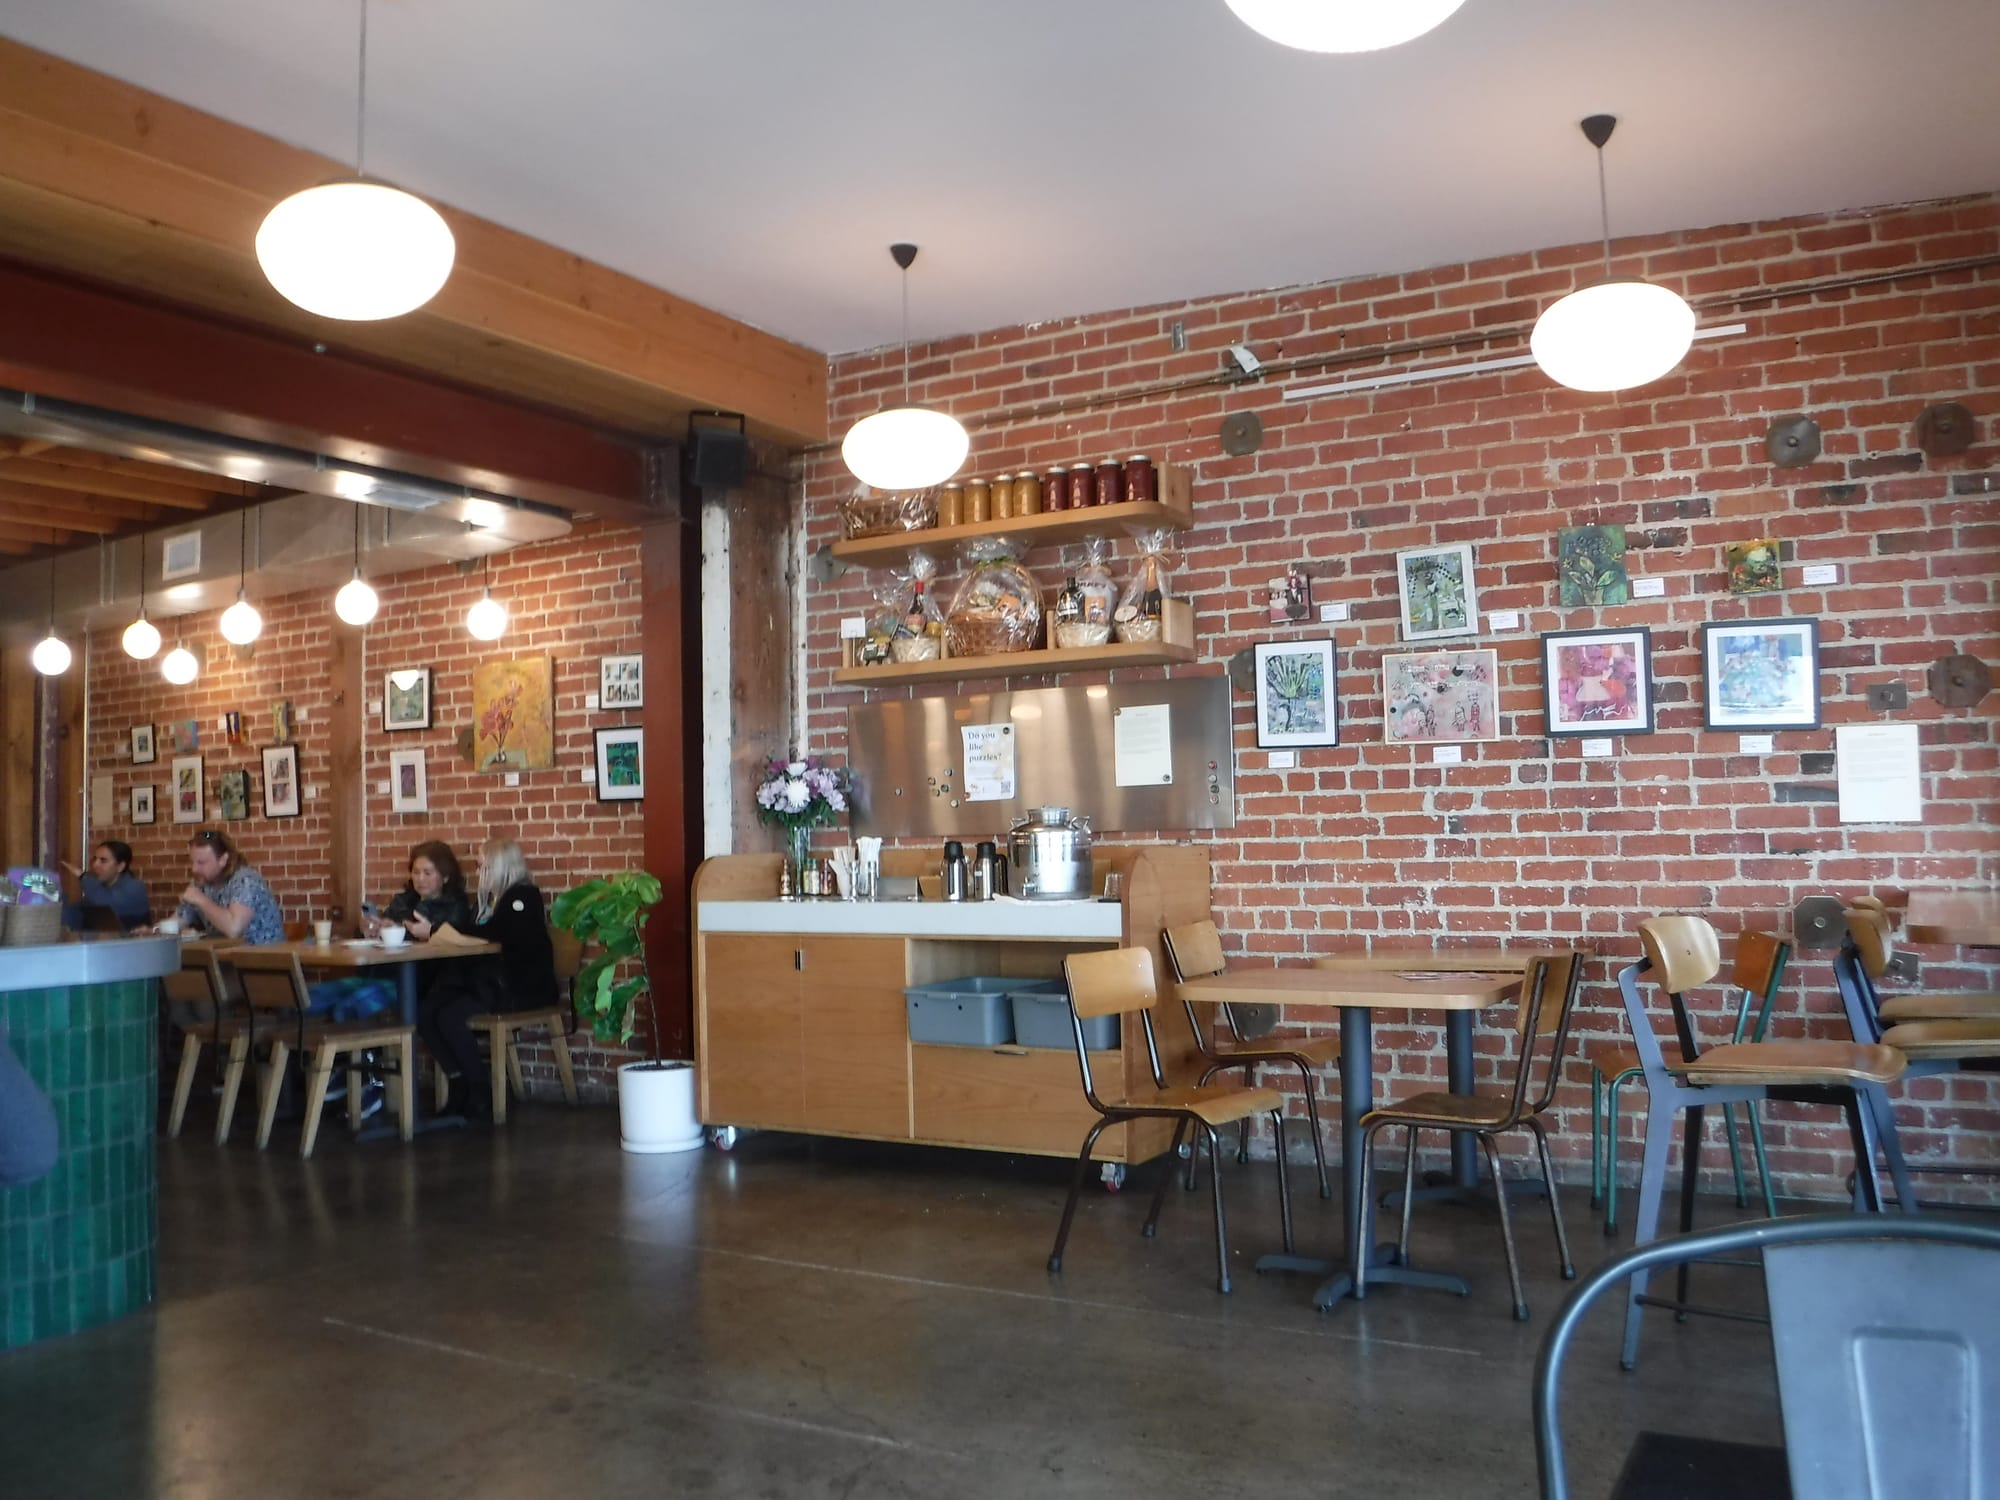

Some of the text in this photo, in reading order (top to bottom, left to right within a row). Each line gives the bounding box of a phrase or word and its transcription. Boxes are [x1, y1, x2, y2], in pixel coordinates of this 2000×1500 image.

[981, 732, 995, 740] you
[969, 743, 983, 751] like
[969, 753, 1002, 764] puzzles?
